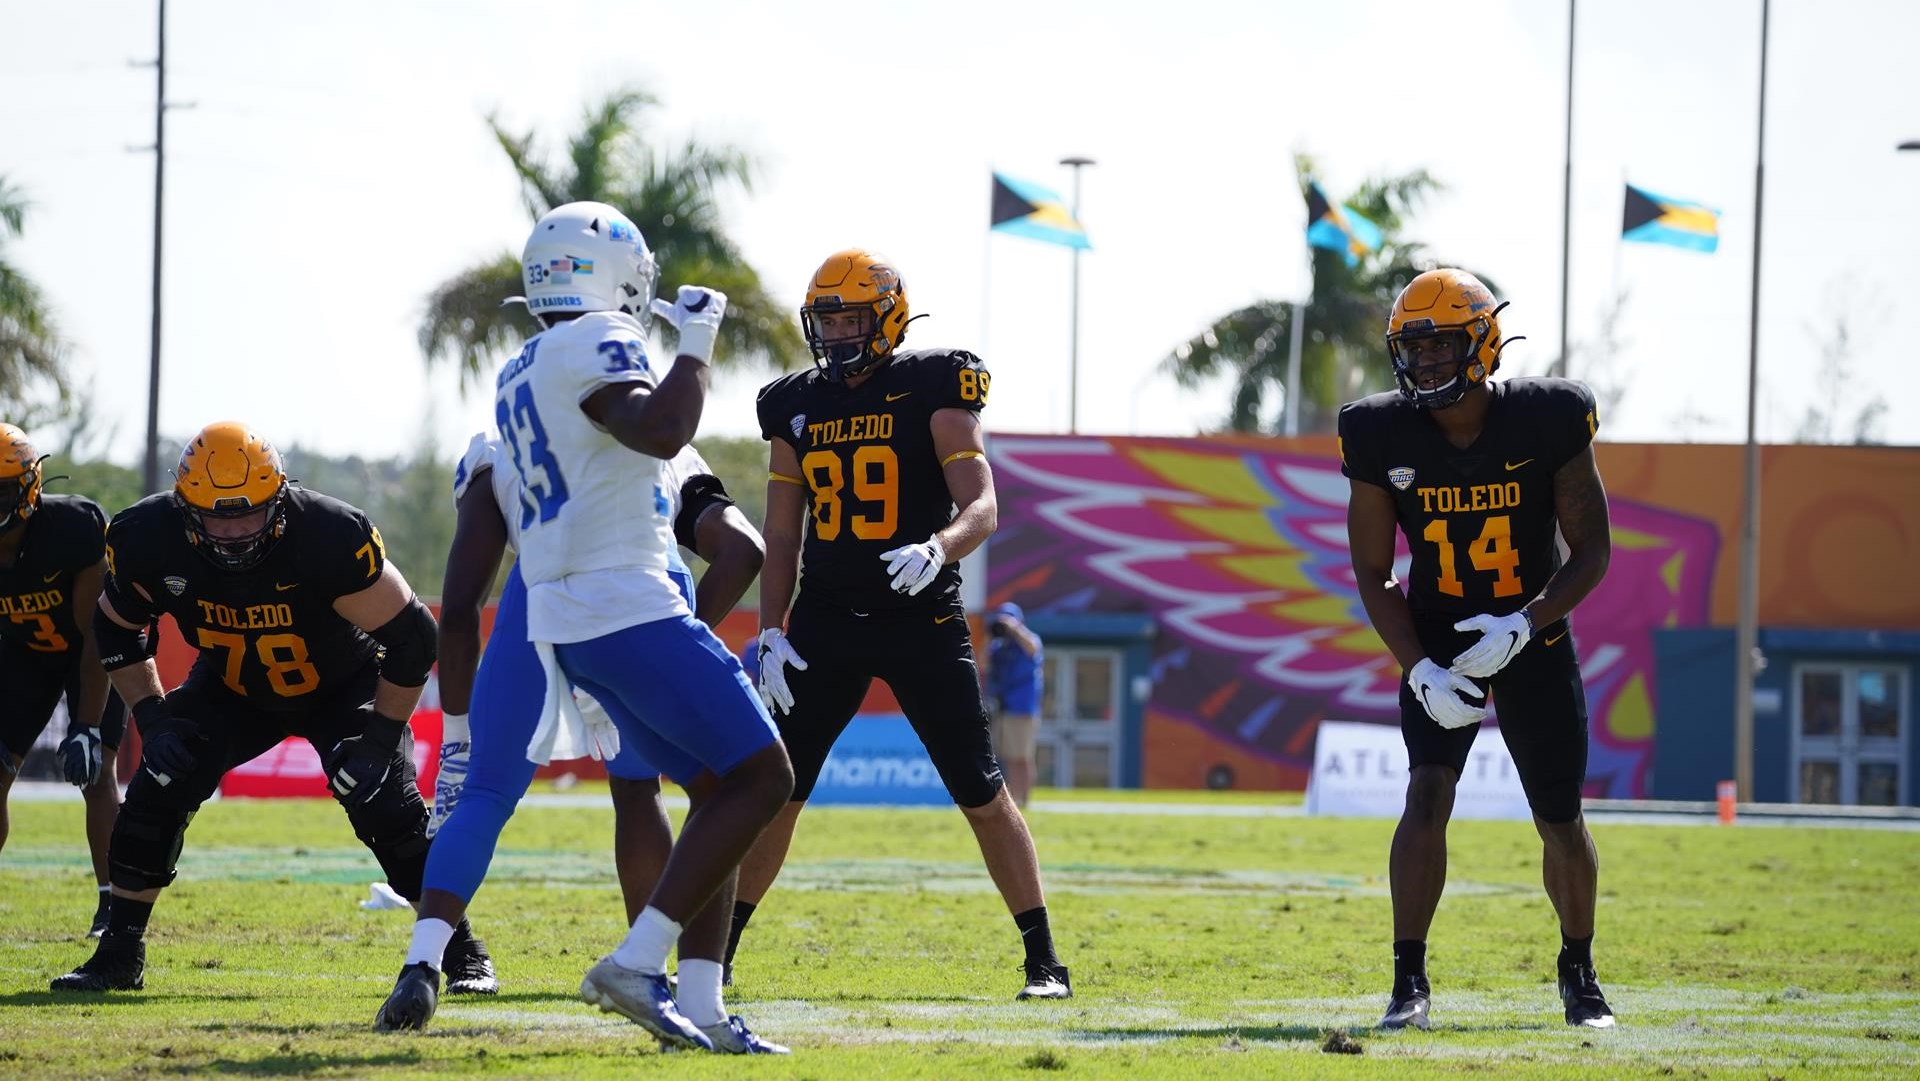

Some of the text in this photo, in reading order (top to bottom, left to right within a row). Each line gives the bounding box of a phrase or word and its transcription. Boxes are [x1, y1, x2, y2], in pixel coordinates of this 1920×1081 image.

[528, 264, 543, 284] 33
[543, 296, 582, 307] RAIDERS
[959, 368, 990, 404] 89
[808, 413, 893, 447] TOLEDO
[802, 445, 899, 541] 89
[1417, 482, 1521, 513] TOLEDO
[1423, 515, 1523, 598] 14
[0, 589, 63, 614] OLEDO
[197, 600, 293, 630] TOLEDO
[10, 612, 69, 652] 3
[196, 630, 320, 697] 78
